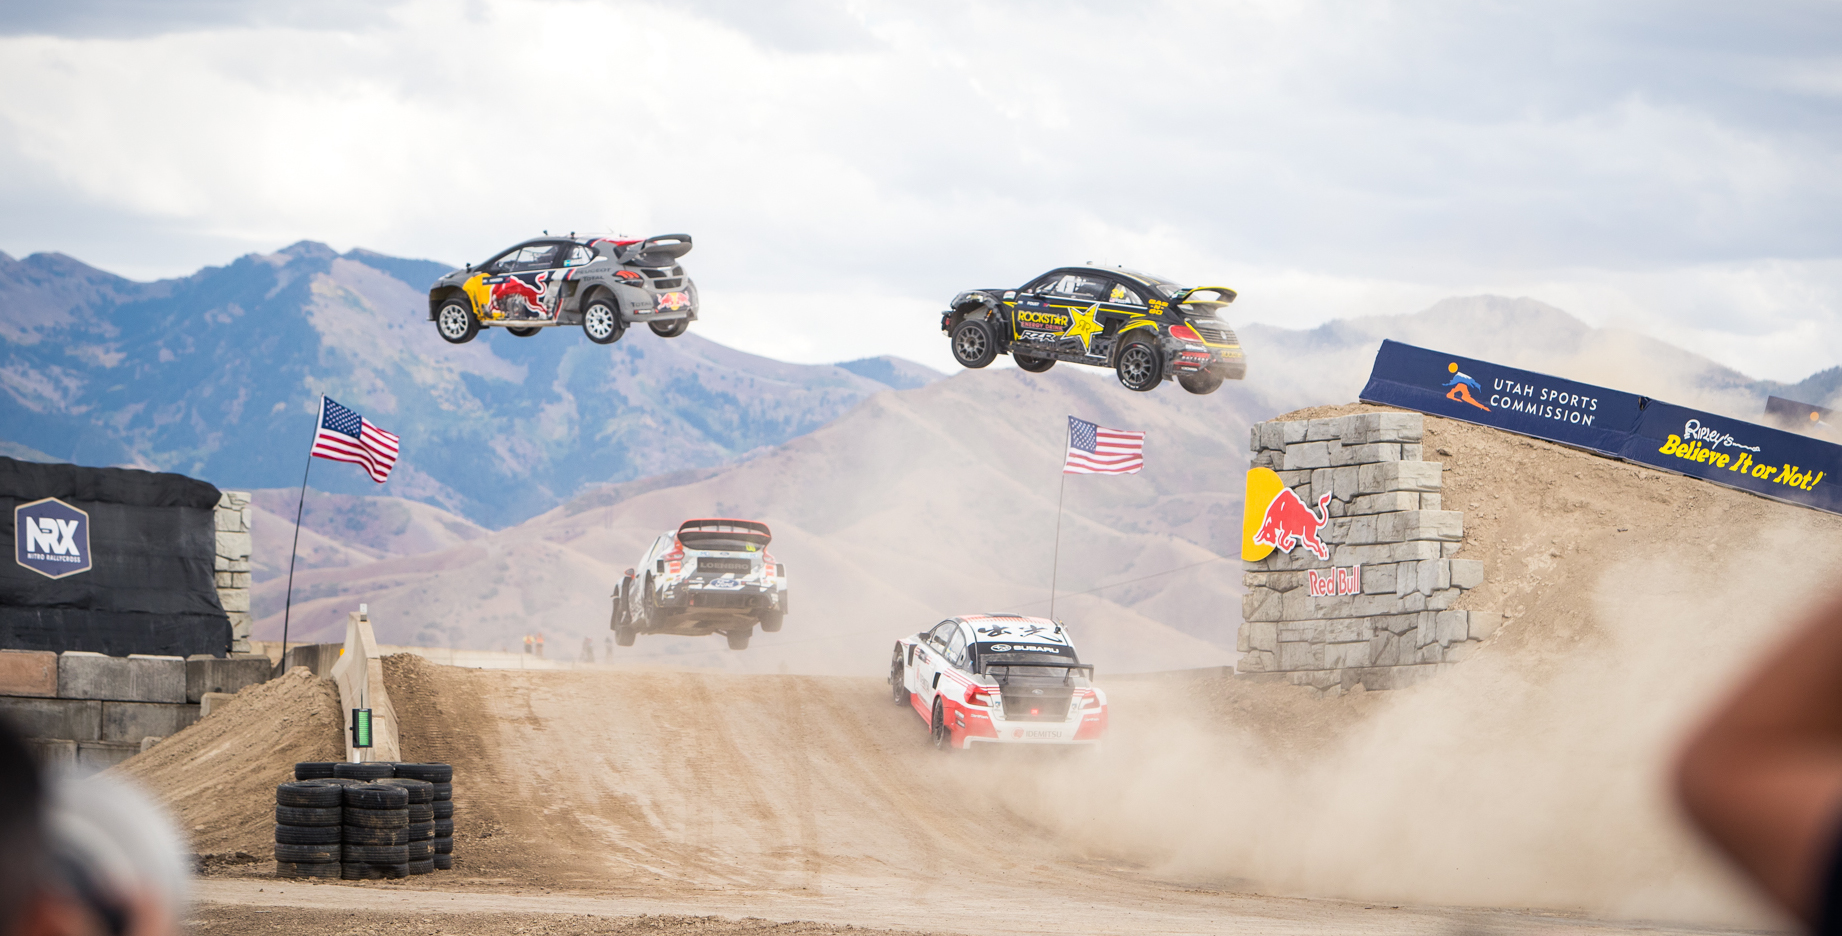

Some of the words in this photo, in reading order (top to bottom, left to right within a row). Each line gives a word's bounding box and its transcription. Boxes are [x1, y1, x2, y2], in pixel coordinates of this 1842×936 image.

[575, 267, 612, 275] PEUGEOT
[1110, 288, 1125, 299] 34
[1148, 299, 1169, 307] GAS
[1148, 308, 1164, 316] GO
[1021, 321, 1044, 329] ENERGY
[1020, 329, 1056, 342] RZR
[1493, 378, 1534, 398] UTAH
[1540, 388, 1598, 411] SPORTS
[1489, 394, 1593, 427] COMMISSION
[1658, 434, 1730, 468] Believe
[1729, 452, 1753, 474] It
[1751, 464, 1778, 480] or
[1773, 463, 1824, 491] Not!
[25, 516, 81, 556] NRX
[27, 552, 46, 561] NITRO
[46, 554, 81, 564] RALLYCROSS
[700, 561, 749, 570] LOENBRO
[715, 579, 736, 588] Ford
[1308, 567, 1336, 596] Red
[1338, 565, 1360, 595] Bull
[1013, 645, 1060, 654] SUBARU
[1025, 730, 1063, 738] IDEMITSU
